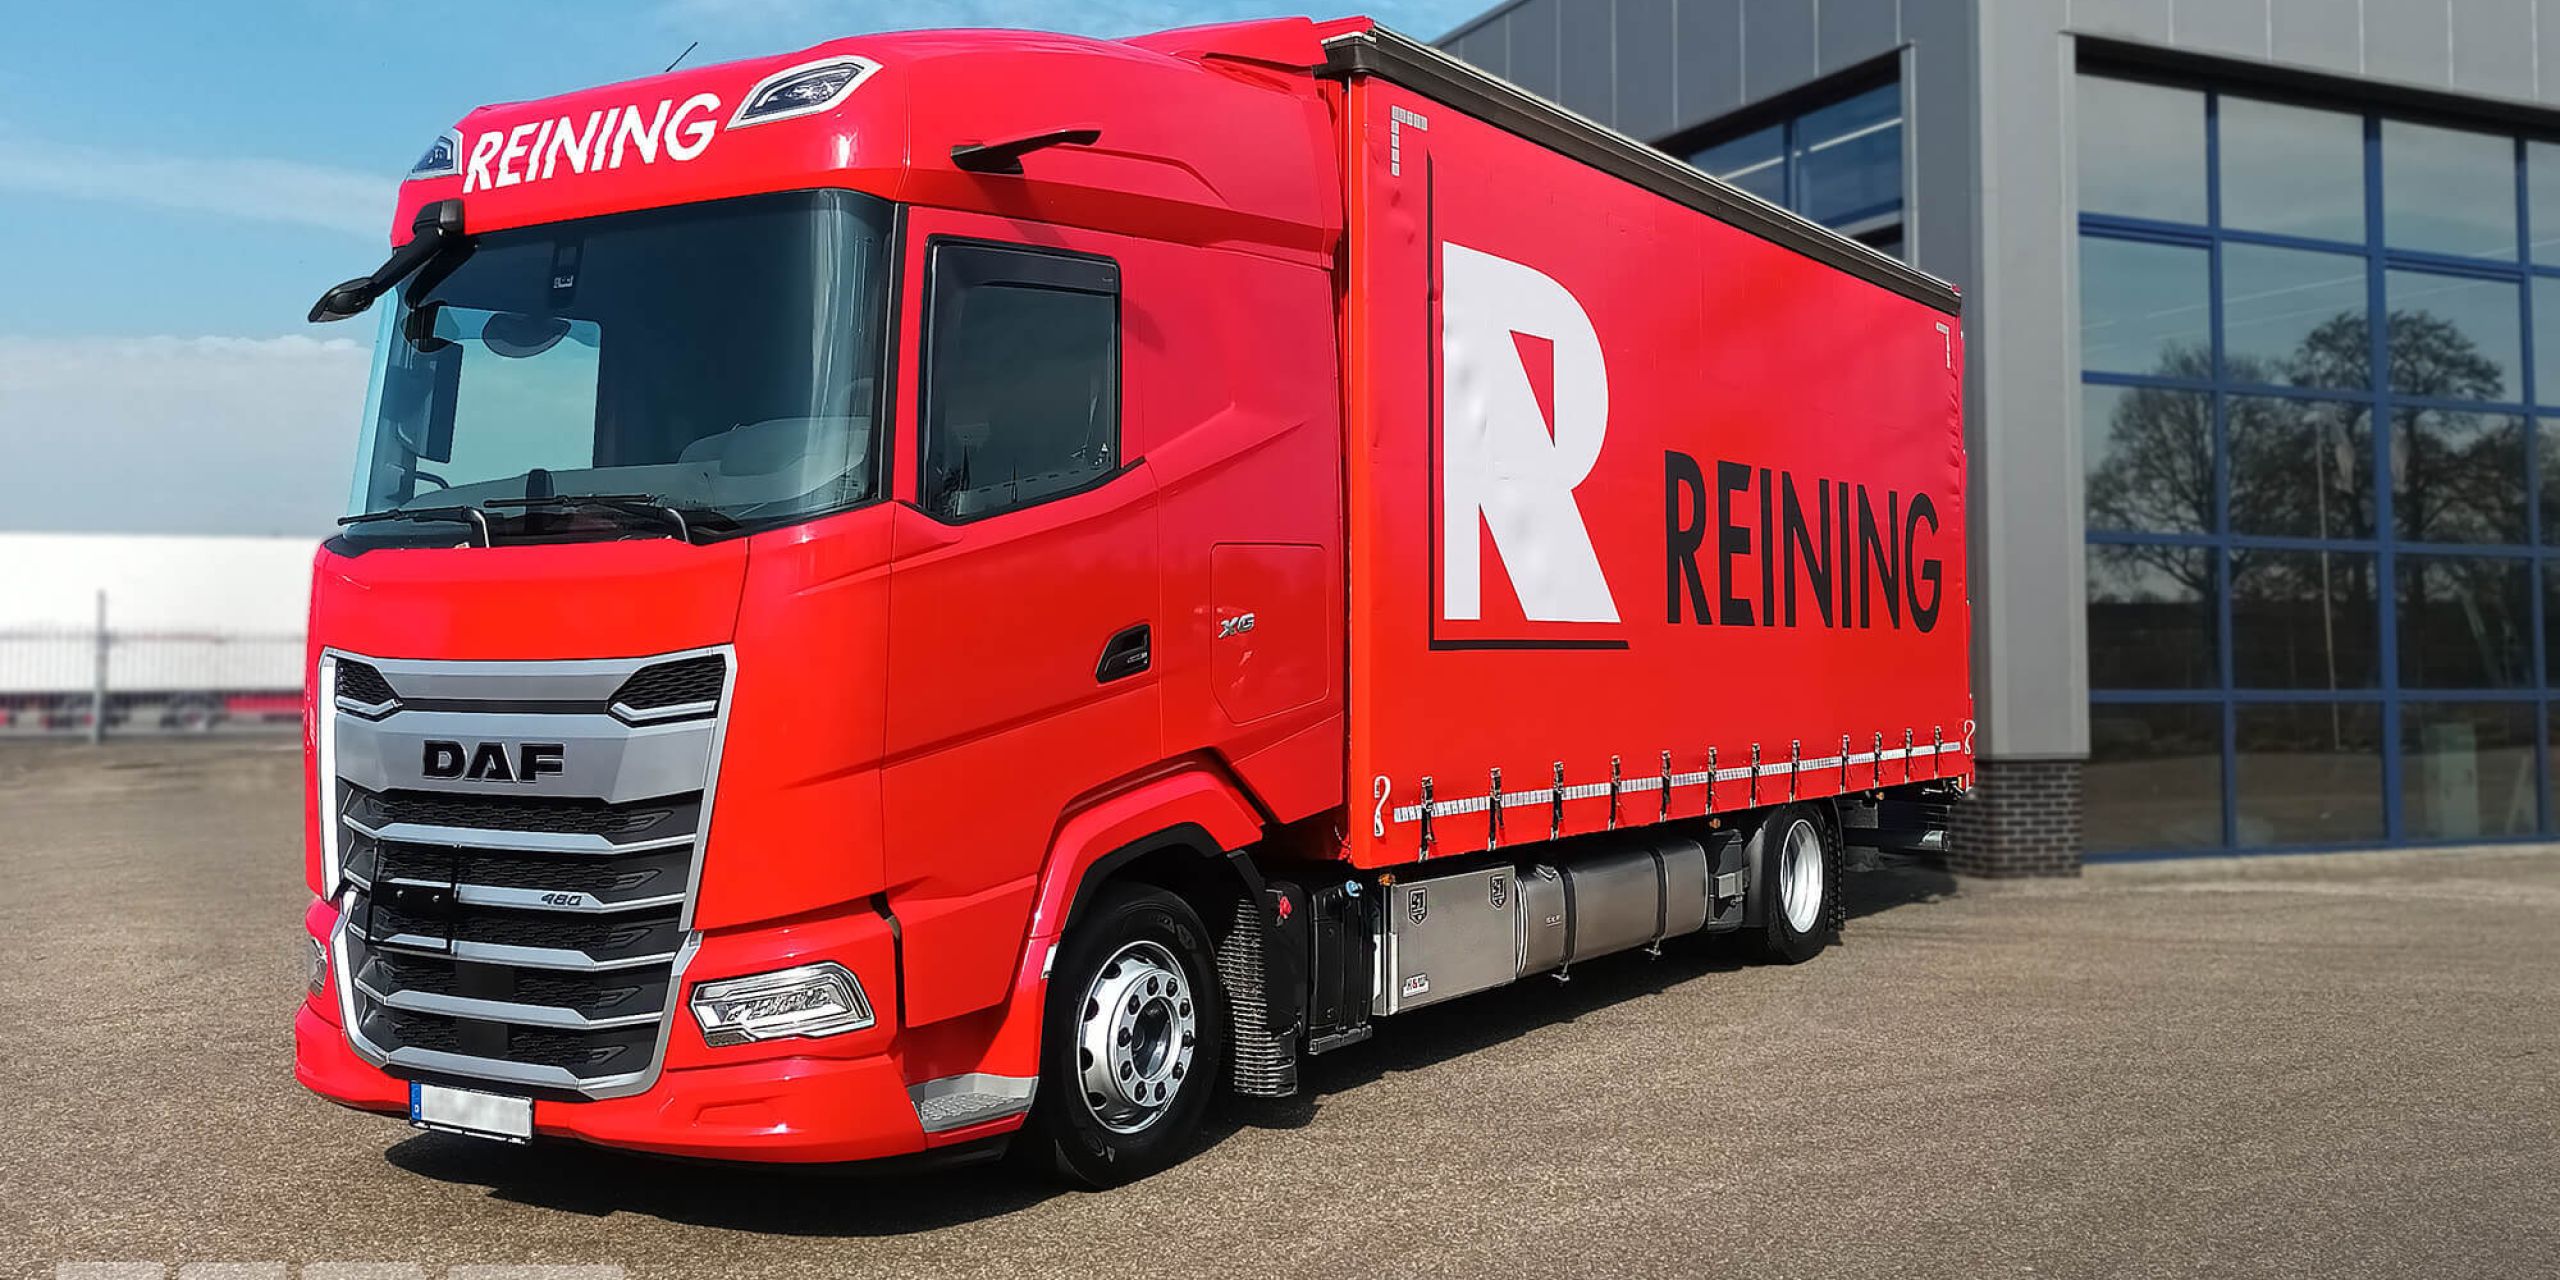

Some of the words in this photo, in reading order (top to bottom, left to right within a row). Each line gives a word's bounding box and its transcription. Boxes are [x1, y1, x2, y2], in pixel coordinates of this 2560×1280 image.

[462, 92, 721, 193] REINING
[1442, 241, 1621, 623] R
[1664, 449, 1942, 633] REINING
[1218, 612, 1255, 639] XG
[422, 740, 567, 784] DAF
[541, 893, 582, 906] 480
